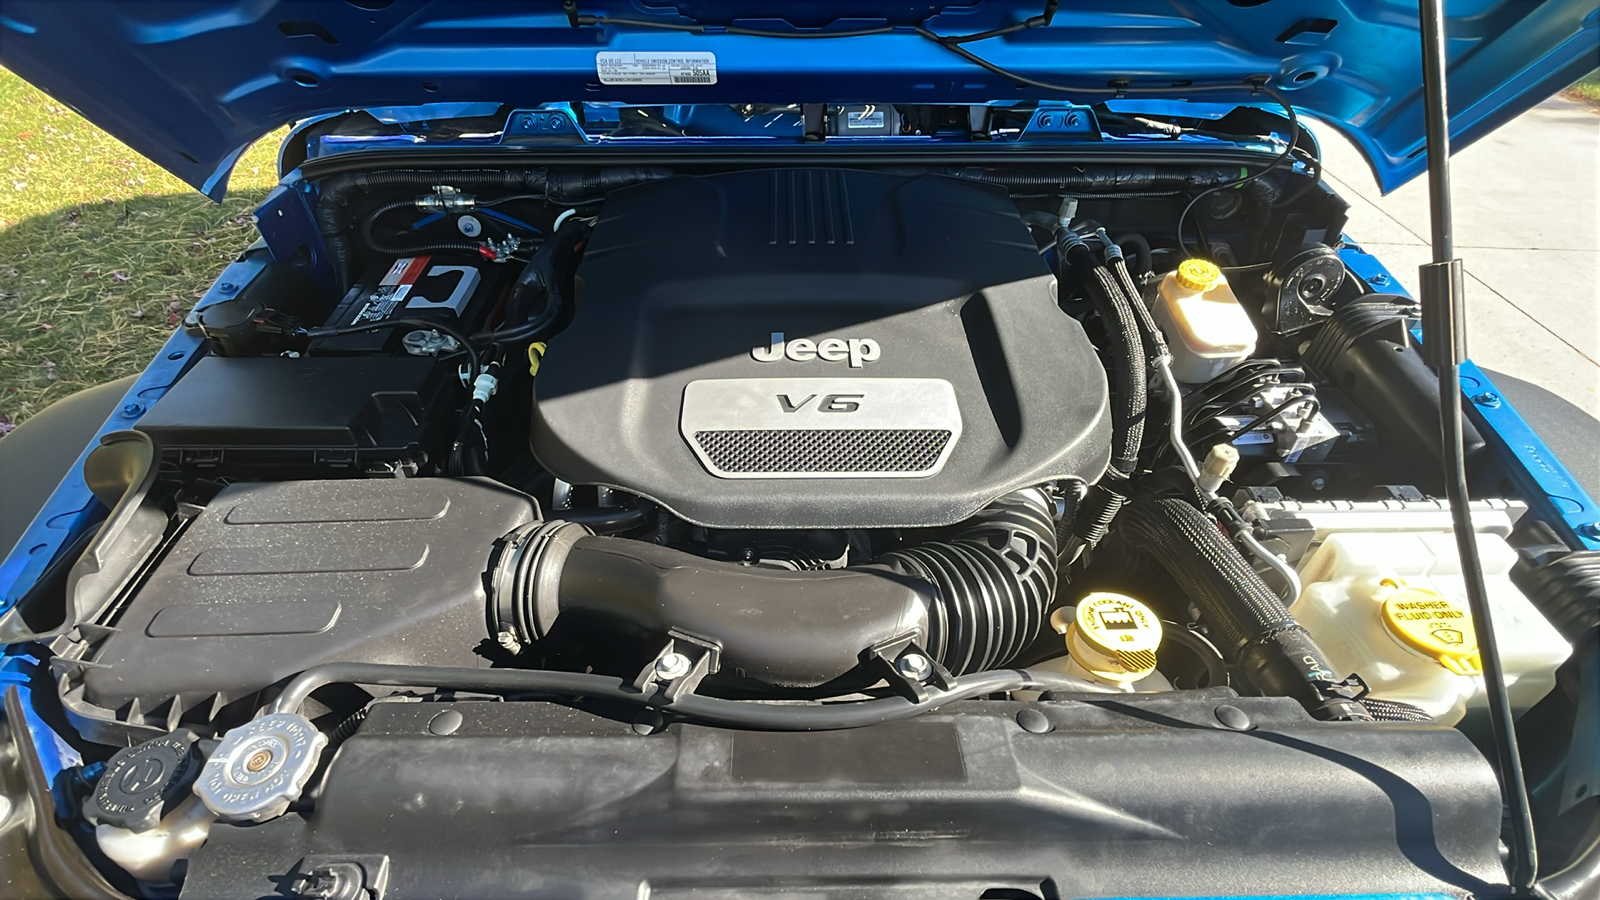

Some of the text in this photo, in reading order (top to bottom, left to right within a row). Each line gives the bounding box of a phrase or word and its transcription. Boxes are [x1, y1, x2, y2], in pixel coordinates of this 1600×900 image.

[751, 332, 881, 368] Jeep
[776, 393, 865, 413] V6
[1394, 601, 1449, 611] WASHER
[1393, 610, 1465, 621] FLUID ONLY
